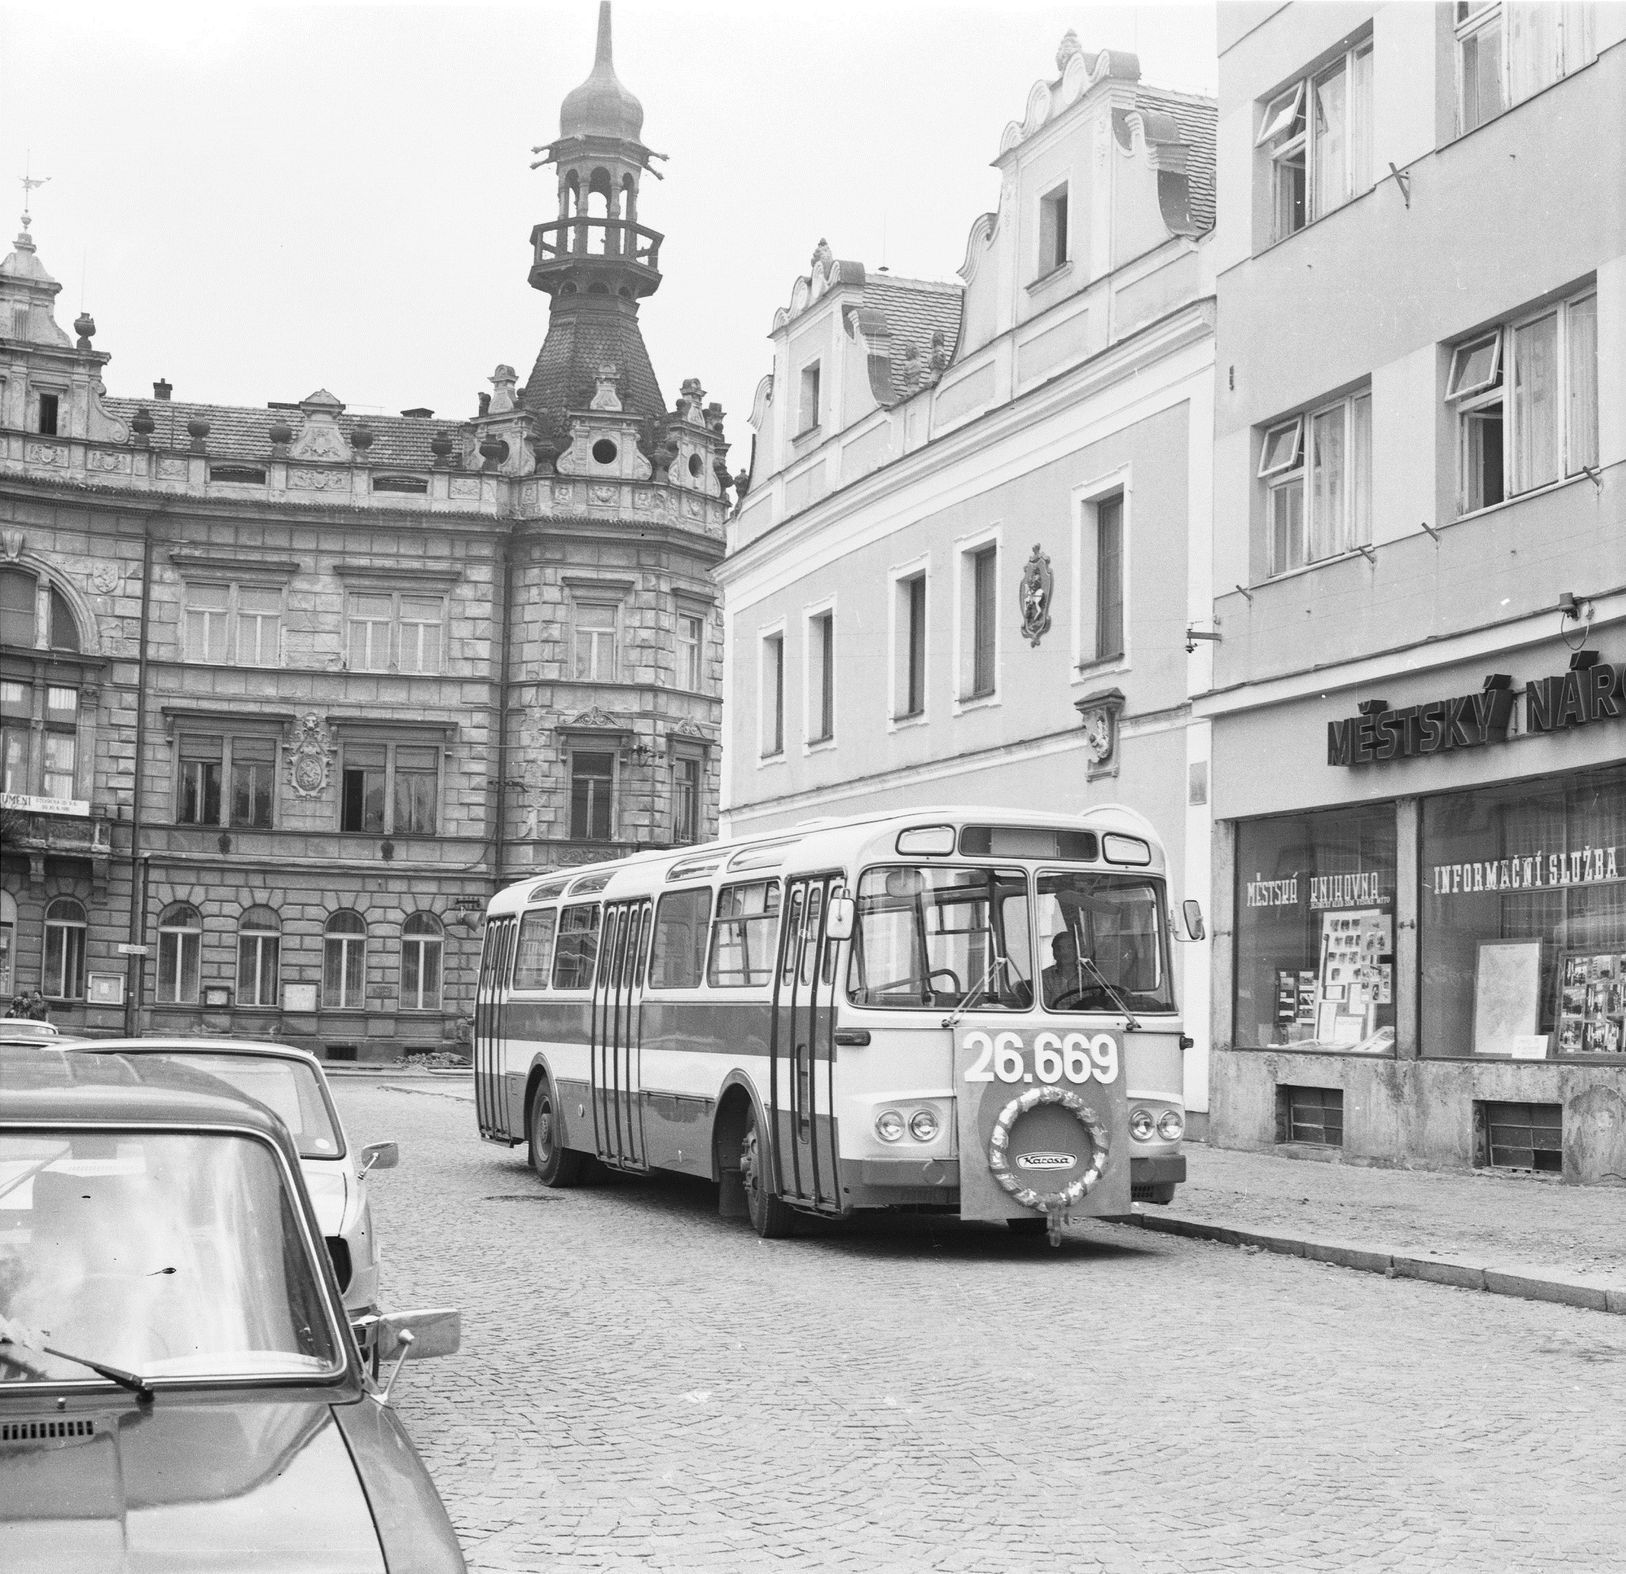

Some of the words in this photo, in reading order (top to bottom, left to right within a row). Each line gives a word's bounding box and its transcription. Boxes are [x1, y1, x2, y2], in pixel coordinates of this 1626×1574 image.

[1328, 674, 1511, 766] MĚSTSKÝ
[1526, 651, 1626, 733] NÁR
[1247, 872, 1298, 907] MĚSTSKÁ
[1310, 872, 1379, 902] KNIHOVNA
[1434, 850, 1542, 895] INFORMAČNÍ
[1549, 846, 1618, 885] SLUŽBA
[963, 1031, 1119, 1084] 26.669
[1024, 1156, 1070, 1165] Karosa
